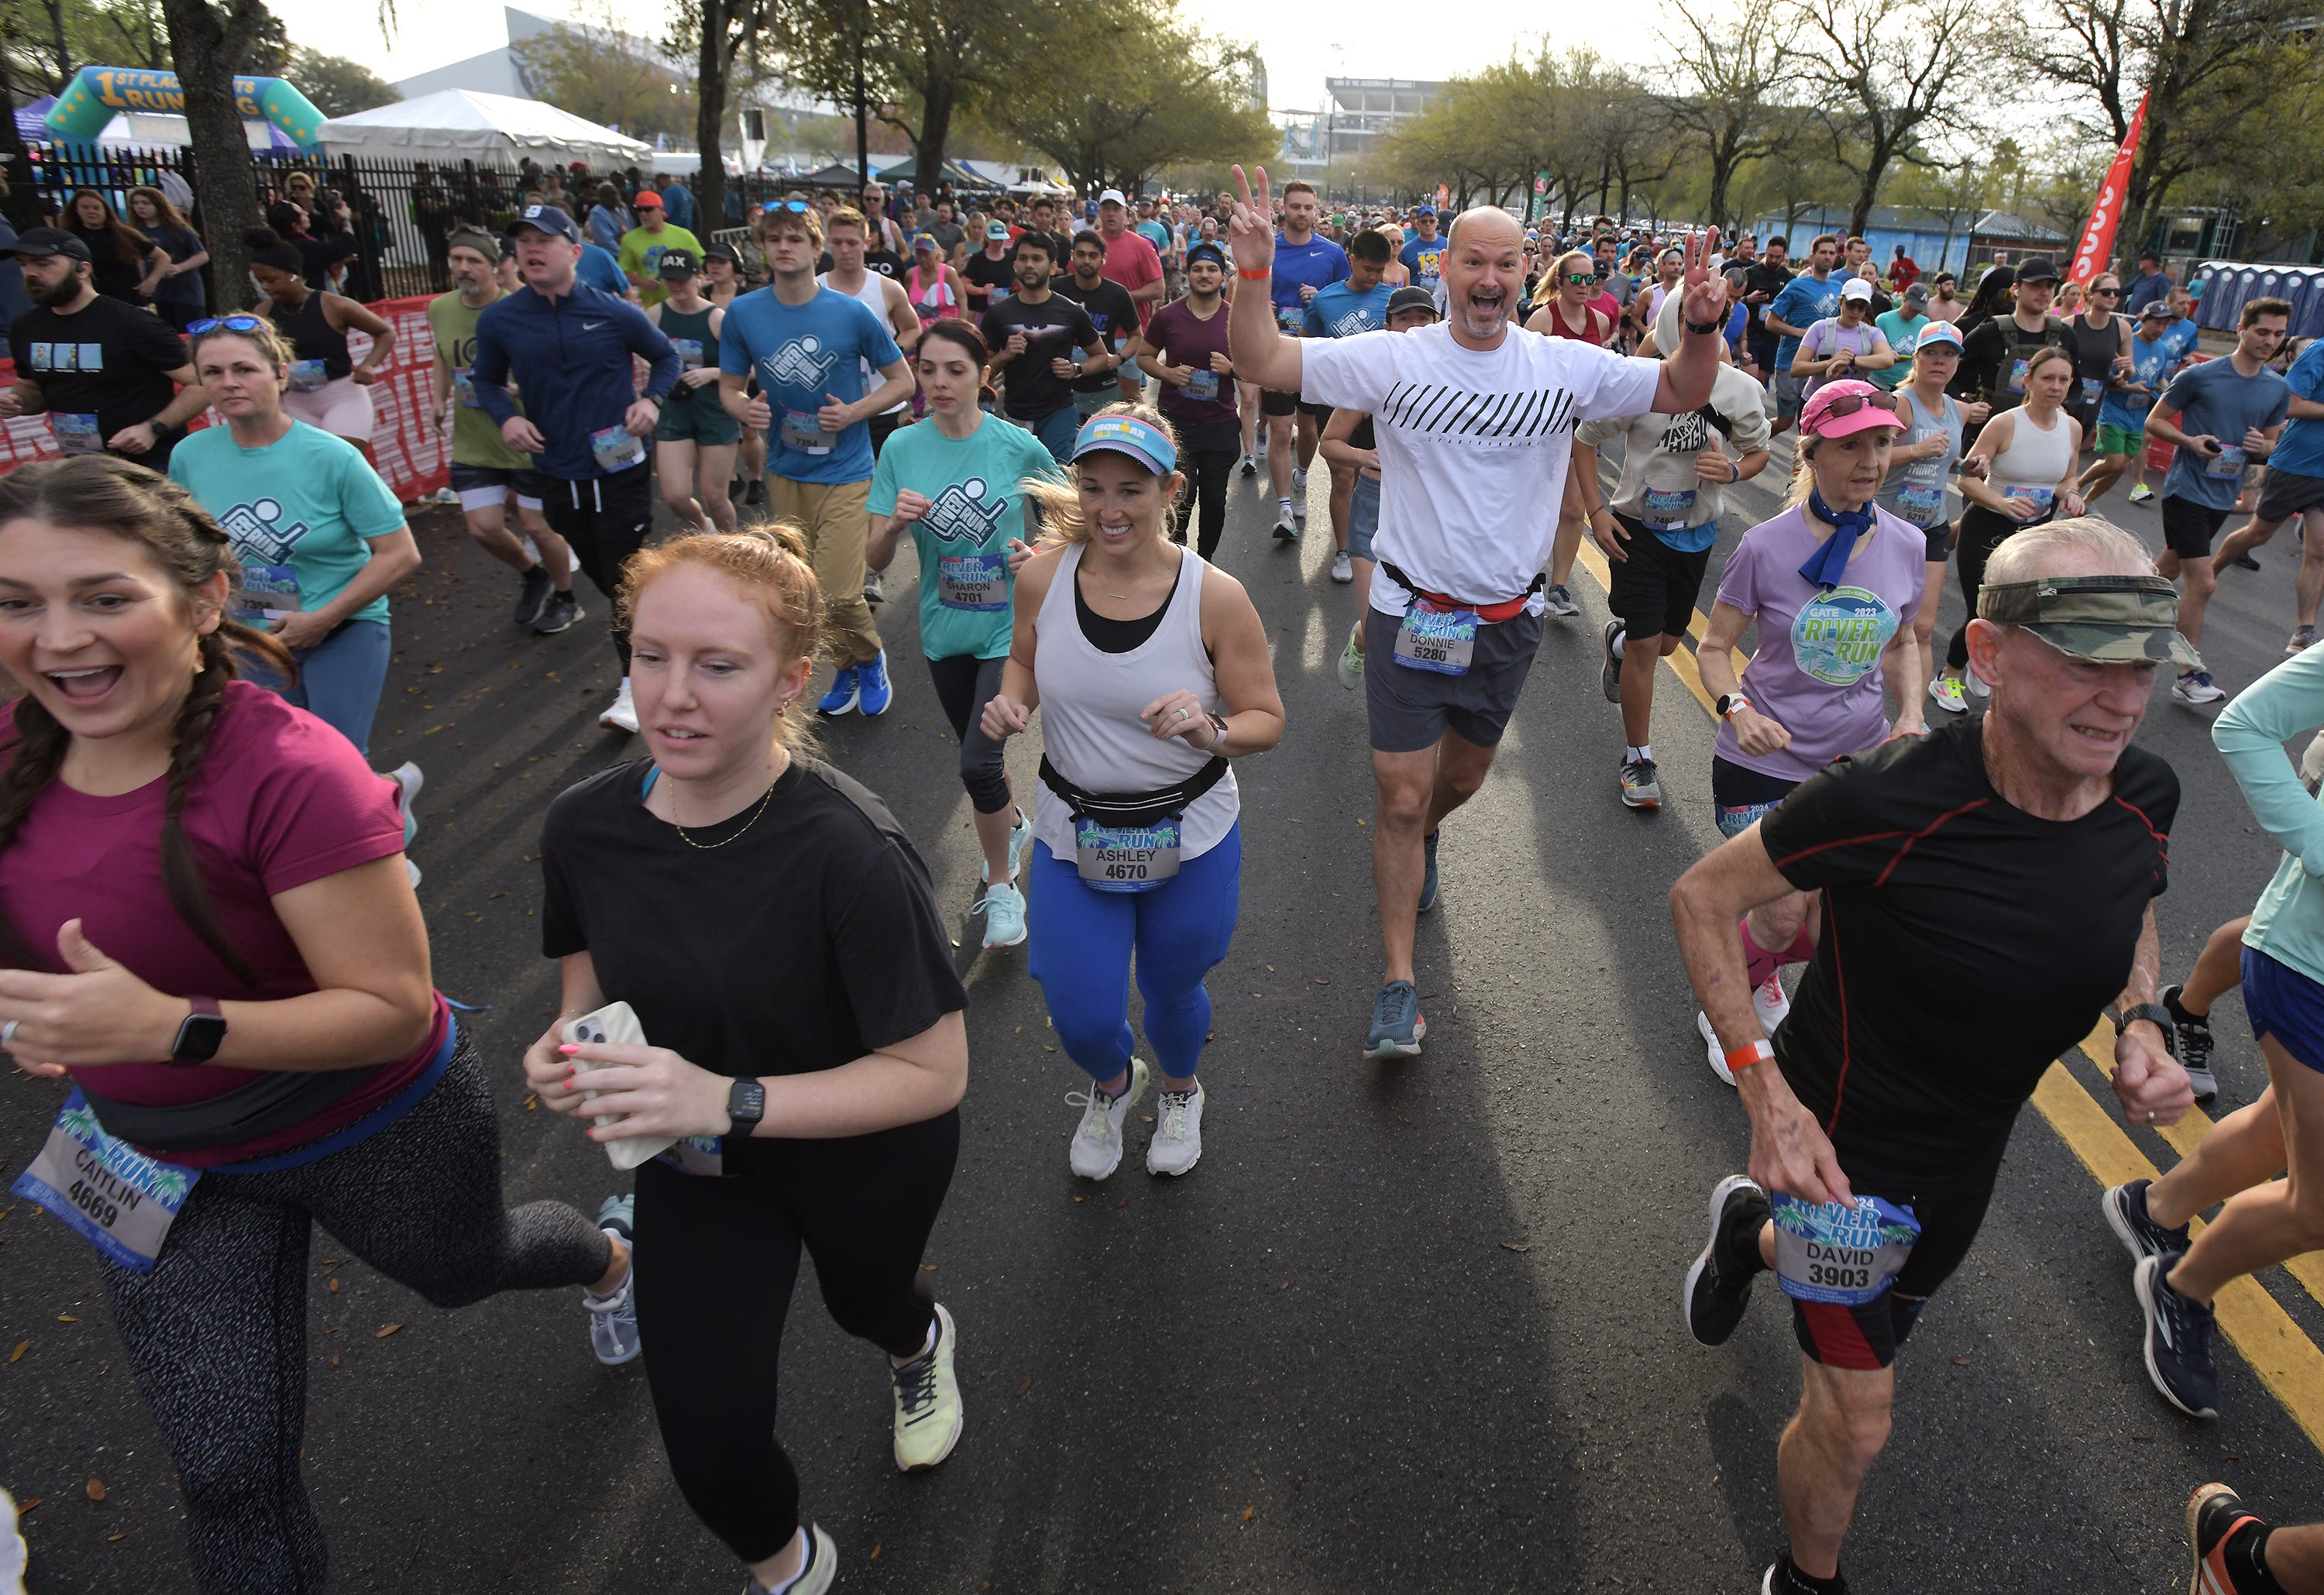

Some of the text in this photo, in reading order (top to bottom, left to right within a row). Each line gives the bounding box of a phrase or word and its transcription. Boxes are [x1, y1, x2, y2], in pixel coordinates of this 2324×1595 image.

[139, 74, 179, 88] PLAC
[662, 256, 686, 267] JAX
[775, 349, 803, 376] RIVER
[796, 357, 820, 380] RUN
[795, 437, 818, 447] 7354
[1669, 416, 1709, 452] HIGH
[931, 494, 966, 530] RIVER
[1903, 504, 1932, 514] JESSICA
[958, 505, 988, 534] RUN
[244, 528, 281, 557] RUN
[942, 562, 984, 573] RIVER
[961, 572, 989, 582] RUN
[946, 582, 991, 591] SHARON
[955, 592, 982, 603] 4701
[1414, 608, 1456, 627] RIVER
[1810, 607, 1877, 618] GATE 2023
[1428, 625, 1458, 639] RUN
[1804, 618, 1880, 642] RIVER
[1410, 634, 1455, 649] DONNIE
[1414, 646, 1447, 662] 5280
[1835, 641, 1882, 664] RUN
[1726, 812, 1763, 825] RIVE
[1117, 834, 1159, 849] RUN
[1095, 850, 1157, 862] ASHLEY
[1105, 865, 1147, 879] 4670
[103, 1140, 160, 1194] RUN
[75, 1148, 142, 1212] CAITLIN
[67, 1178, 119, 1229] 4669
[1829, 1225, 1883, 1249] RUN
[1807, 1242, 1874, 1265] DAVID
[1808, 1263, 1869, 1287] 3903
